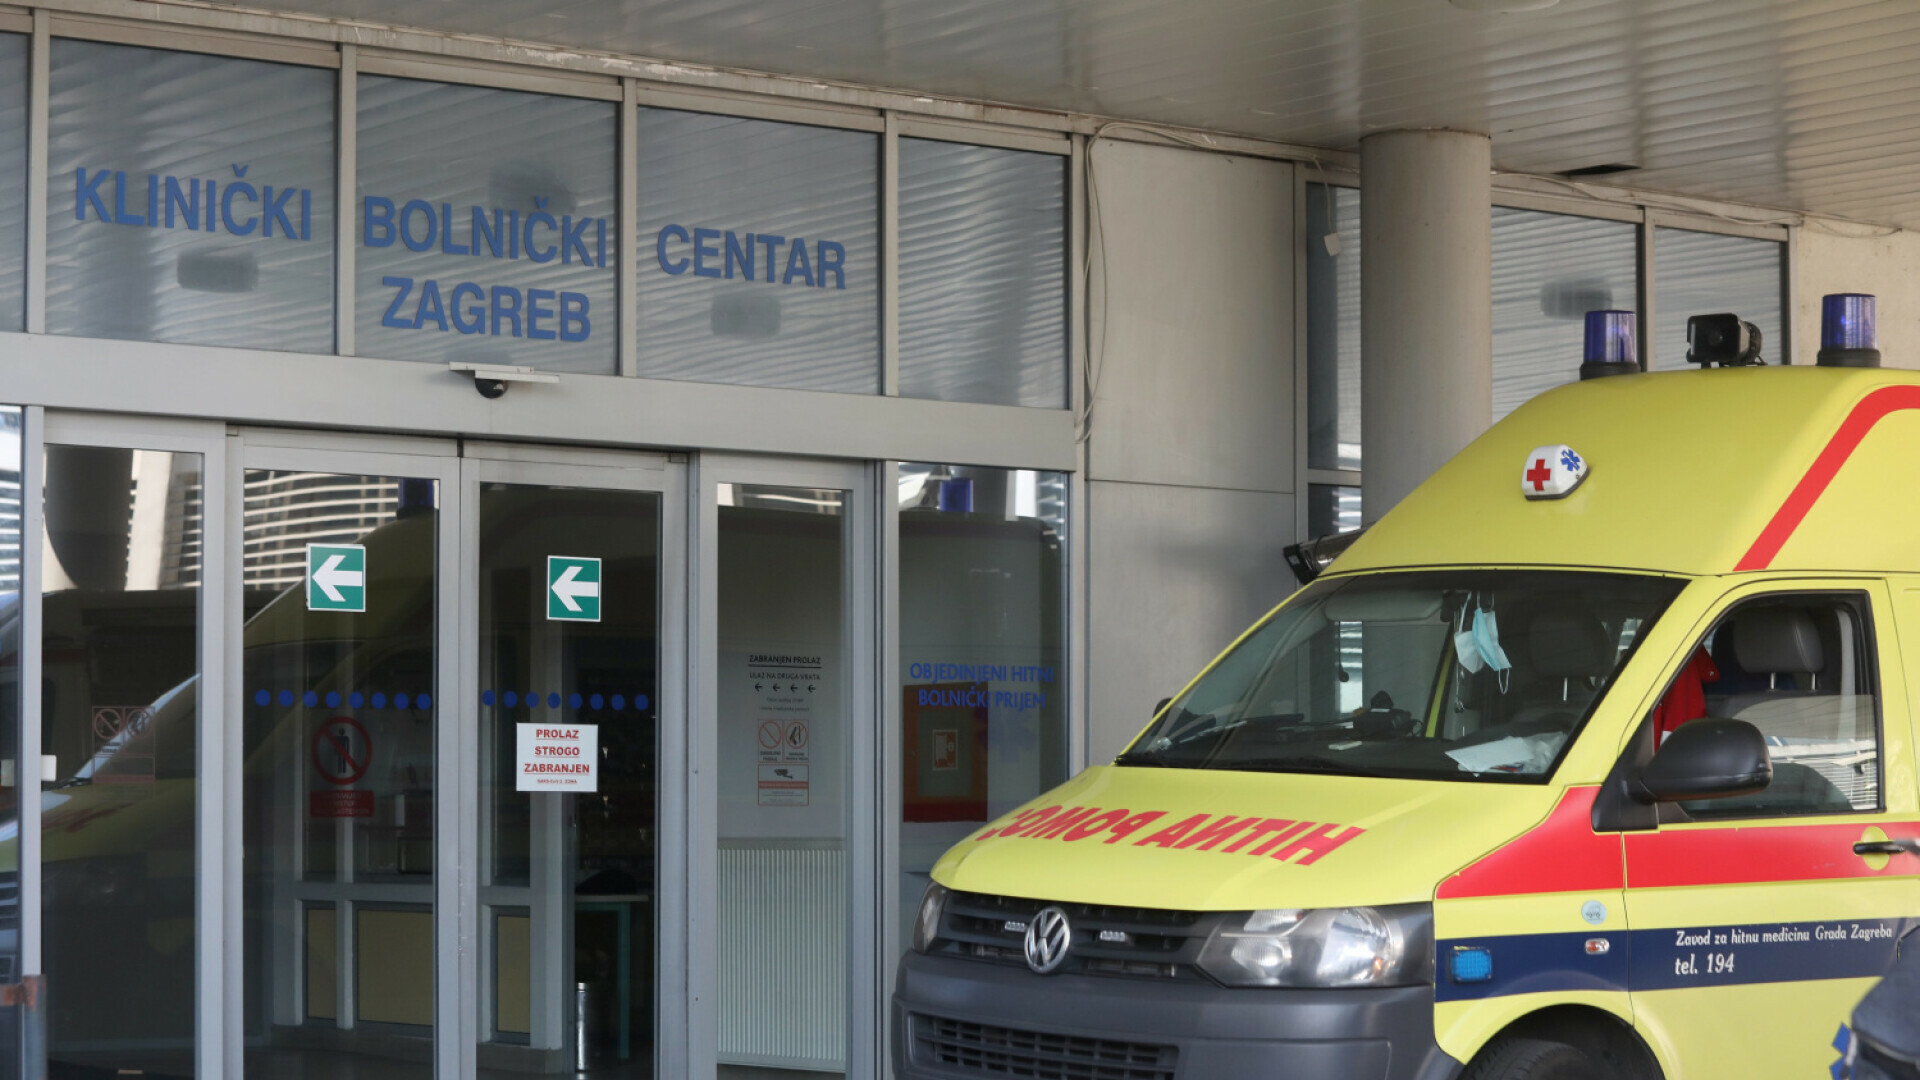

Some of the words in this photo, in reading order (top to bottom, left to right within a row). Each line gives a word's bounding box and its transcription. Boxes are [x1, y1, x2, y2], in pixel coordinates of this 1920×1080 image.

[76, 163, 312, 241] KLINIČKI
[364, 197, 606, 268] BOLNIČKI
[657, 224, 847, 290] CENTAR
[382, 276, 591, 342] ZAGREB
[749, 655, 792, 664] ZABRANJEN
[909, 662, 1007, 685] OBJEDINJENI
[1011, 665, 1054, 683] HITNI
[918, 686, 991, 709] BOLNIČKI
[994, 691, 1046, 712] PRIJEM
[535, 729, 579, 739] PROLAZ
[534, 746, 580, 756] STROGO
[524, 763, 590, 773] ZABRANJEN
[1675, 930, 1711, 947] Zavod
[1714, 933, 1728, 945] za
[1731, 929, 1760, 945] hitnu
[1762, 927, 1811, 943] medicinu
[1815, 924, 1847, 941] Grada
[1850, 923, 1893, 942] Zagreba
[1675, 953, 1699, 975] tel.
[1706, 952, 1735, 974] 194
